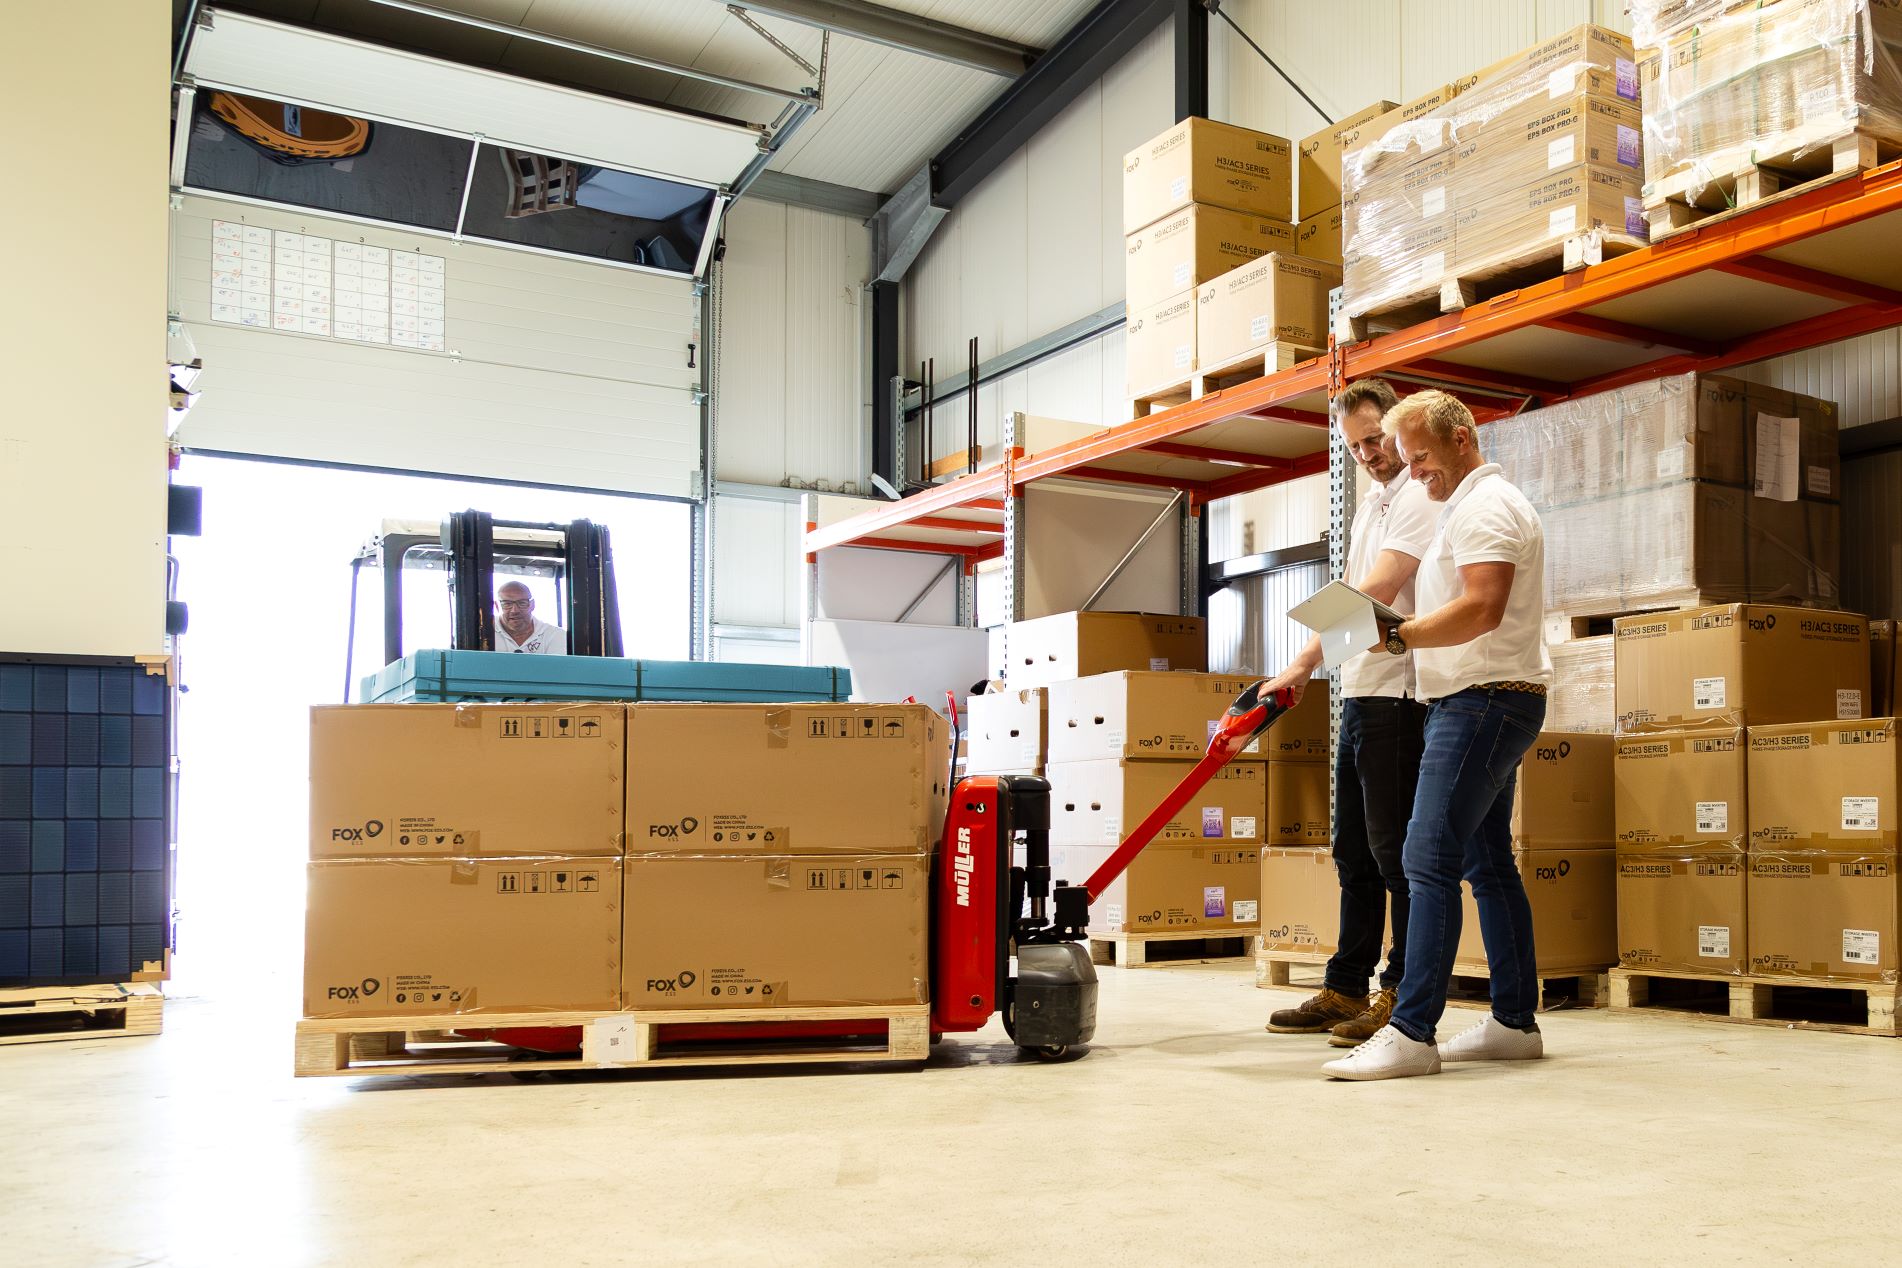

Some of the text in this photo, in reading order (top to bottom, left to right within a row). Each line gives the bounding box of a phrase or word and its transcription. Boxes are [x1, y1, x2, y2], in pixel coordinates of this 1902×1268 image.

[1403, 108, 1413, 117] EPS
[1415, 102, 1427, 112] BOX
[1428, 96, 1440, 106] PRO
[1527, 107, 1571, 129] EPS BOX PRO
[1527, 116, 1578, 140] EPS BOX PRO-G
[1216, 156, 1244, 169] H3/AC3
[1245, 163, 1270, 175] SERIES
[1220, 242, 1248, 253] H3/AC3
[1279, 262, 1299, 272] AC3/H3
[1301, 267, 1322, 276] SERIES
[1229, 275, 1249, 289] H3/AC3
[1249, 266, 1267, 281] SERIES
[1617, 624, 1667, 637] AC3/H3 SERIES
[1749, 619, 1765, 631] FOX
[1800, 620, 1860, 635] H3/AC3 SERIES
[1280, 743, 1293, 751] FOX
[1752, 736, 1810, 746] AC3/H3 SERIES
[1537, 748, 1557, 761] FOX
[1618, 744, 1669, 755] AC3/H3 SERIES
[332, 828, 363, 841] FOX
[649, 825, 679, 838] FOX
[1536, 868, 1557, 880] FOX
[1620, 865, 1671, 873] AC3/H3 SERIES
[1752, 865, 1811, 873] AC3/H3 SERIES
[1138, 915, 1152, 923] FOX
[1270, 929, 1281, 938] FOX
[647, 979, 677, 992] FOX
[328, 986, 359, 1000] FOX
